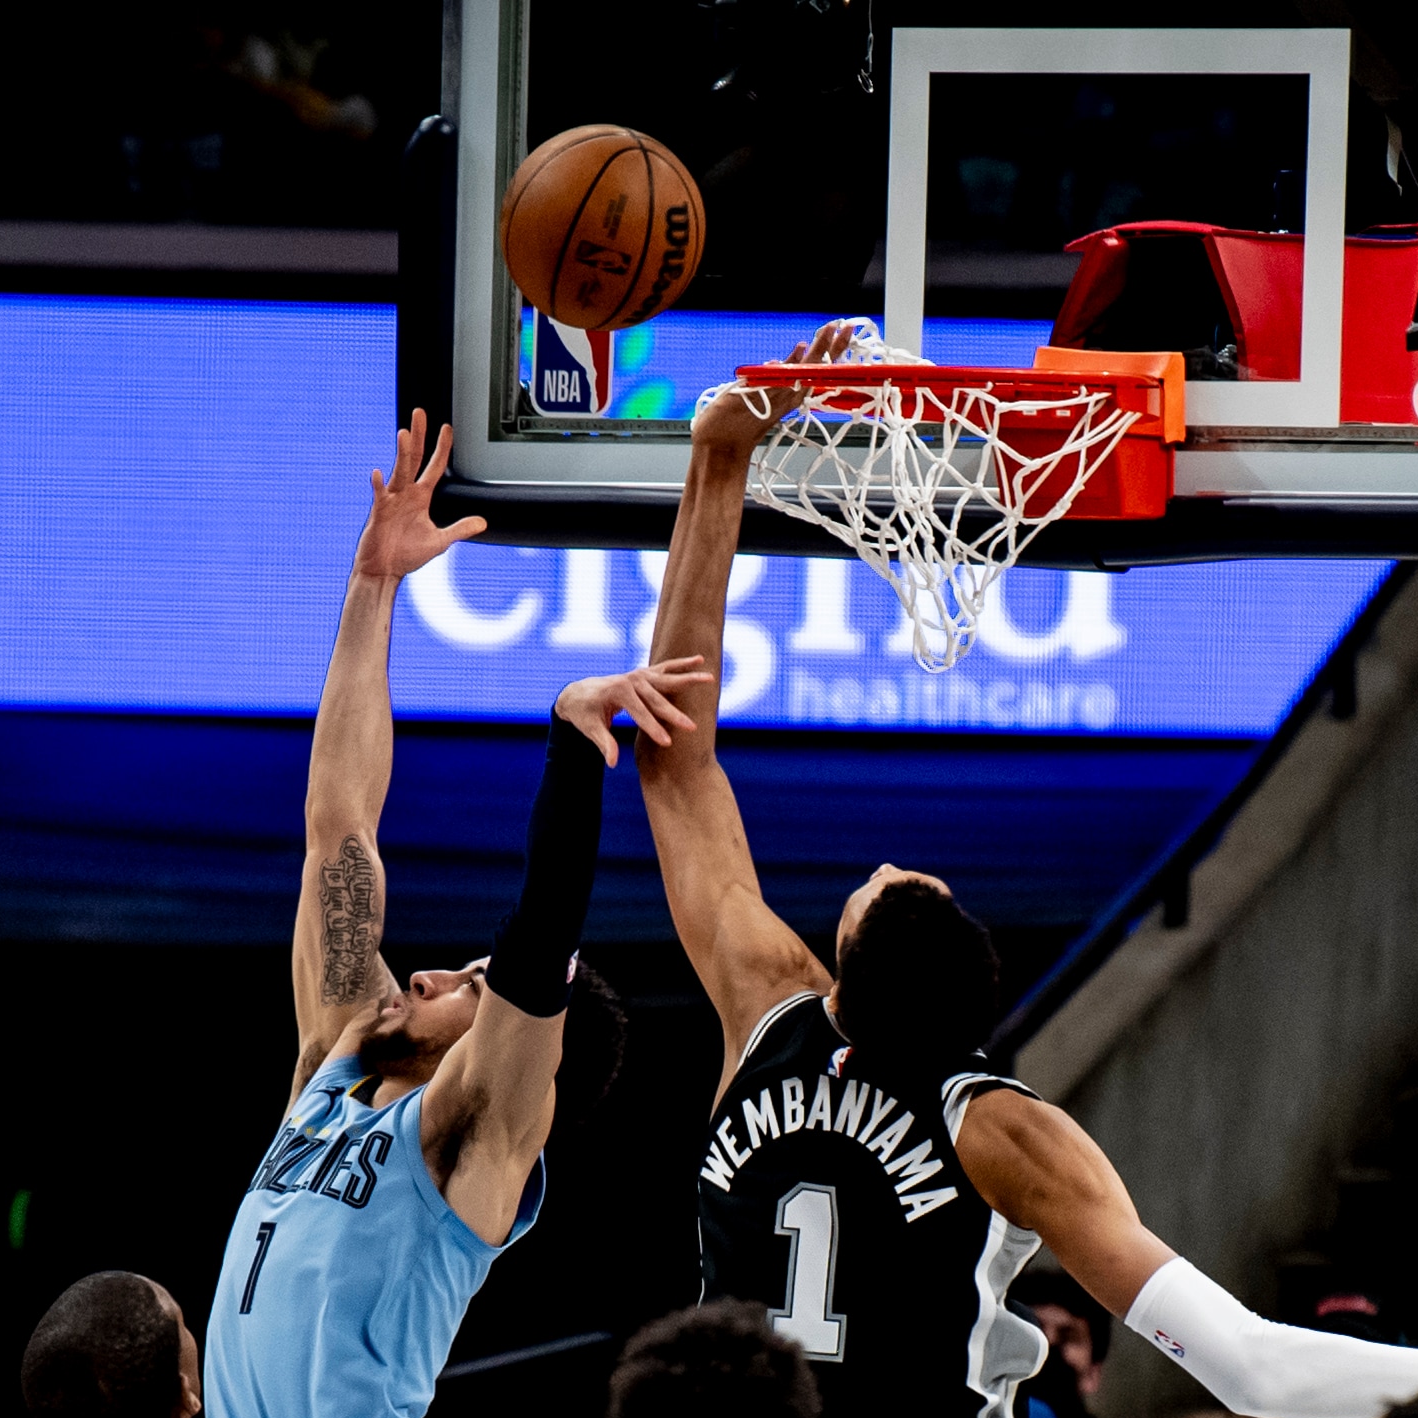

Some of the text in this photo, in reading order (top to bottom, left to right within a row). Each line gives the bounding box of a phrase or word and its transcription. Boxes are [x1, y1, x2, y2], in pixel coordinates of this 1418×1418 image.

[544, 369, 581, 403] NBA
[788, 669, 1119, 730] healthcare
[699, 1074, 958, 1223] WEMBANYAMA
[239, 1221, 277, 1314] 1
[767, 1181, 847, 1363] 1
